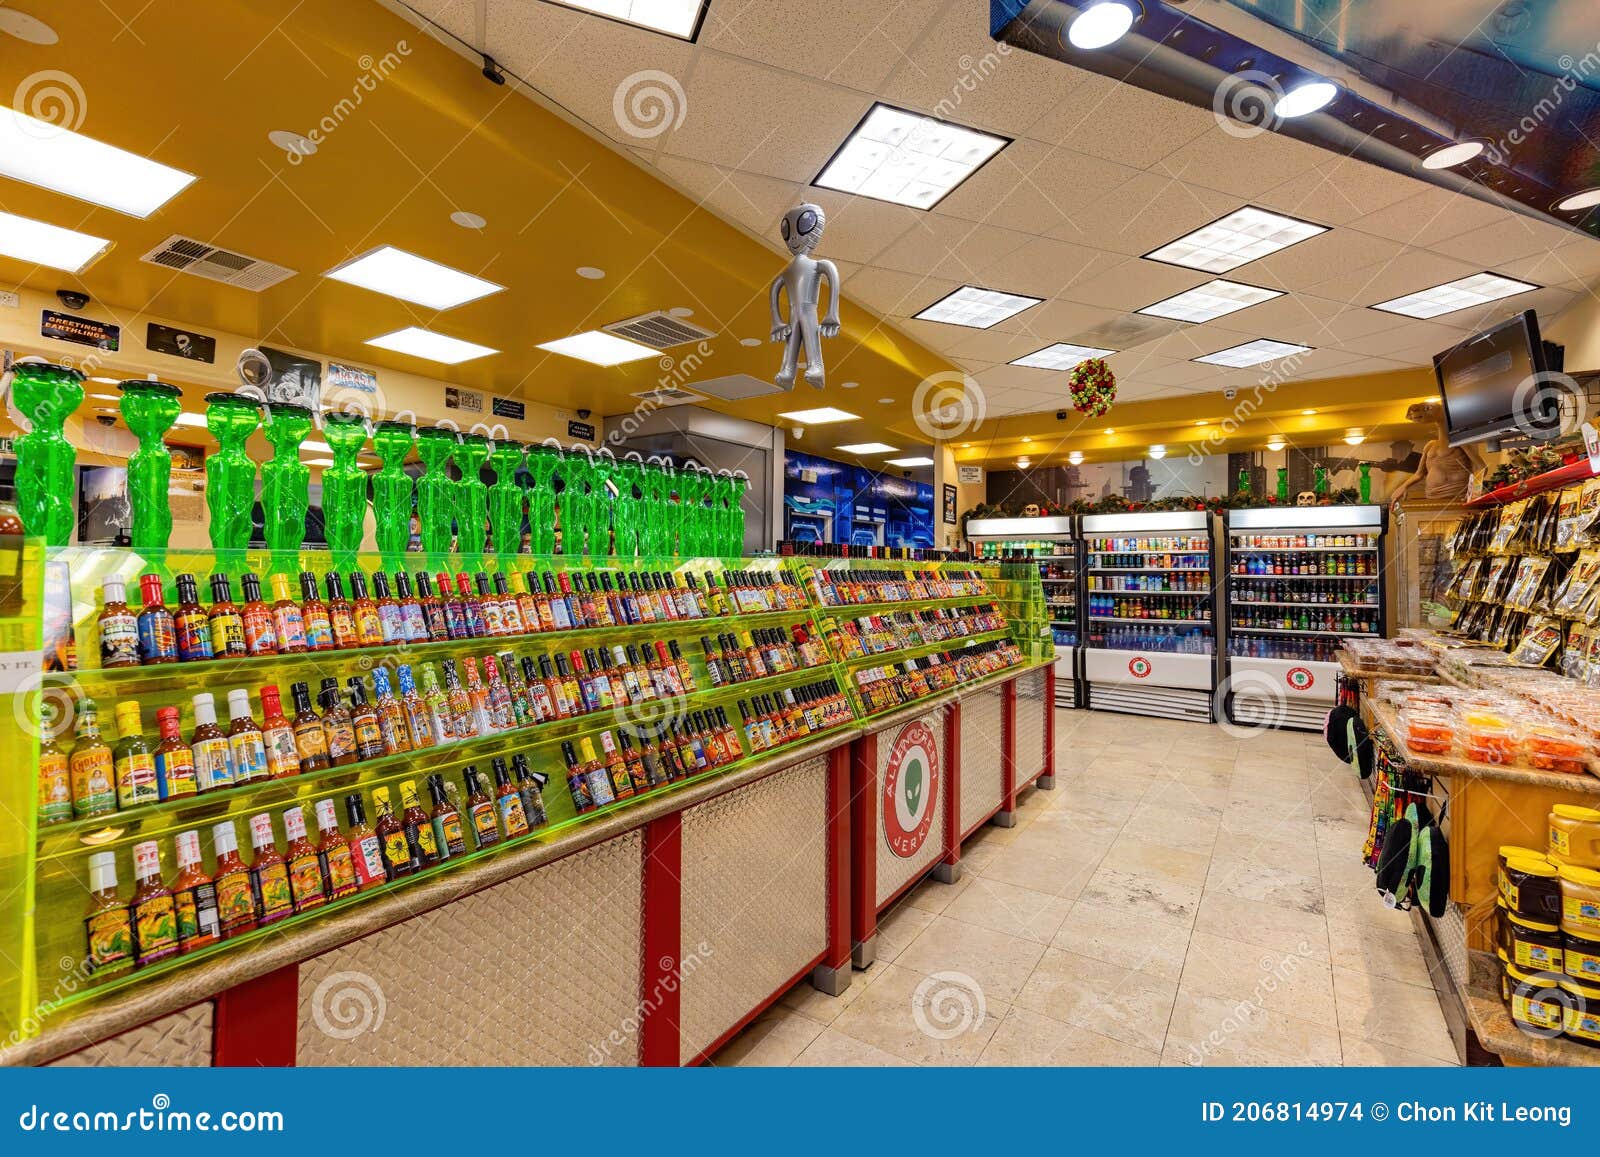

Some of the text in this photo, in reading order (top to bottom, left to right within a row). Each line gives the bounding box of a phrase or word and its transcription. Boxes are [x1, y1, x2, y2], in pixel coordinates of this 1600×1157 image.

[44, 321, 107, 340] EARTHLINGS
[48, 315, 104, 333] GREETINGS
[893, 810, 931, 852] JERKY
